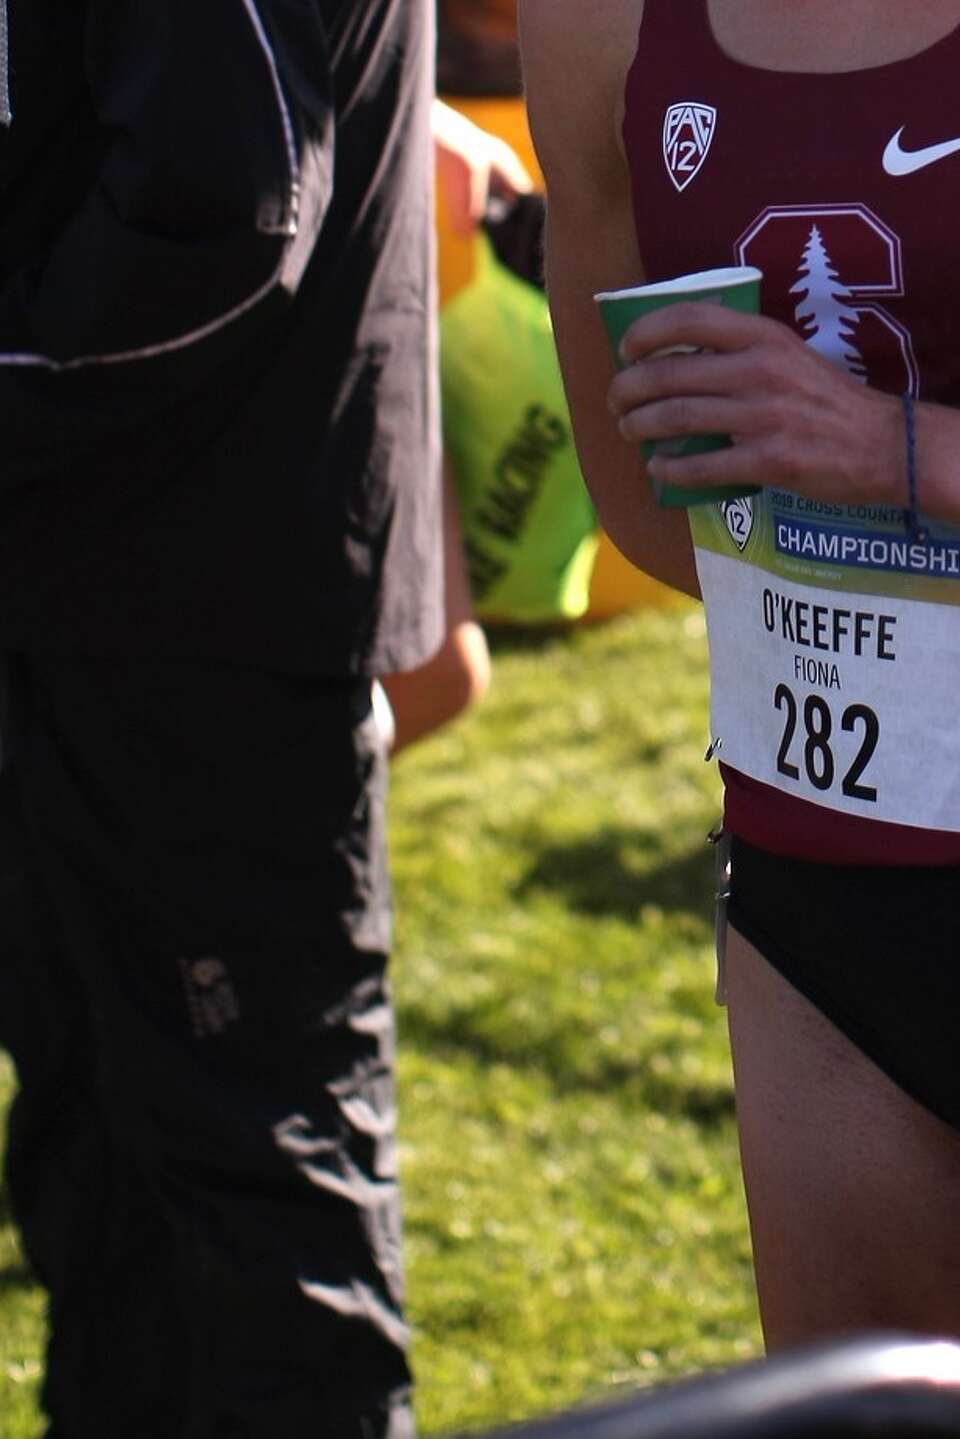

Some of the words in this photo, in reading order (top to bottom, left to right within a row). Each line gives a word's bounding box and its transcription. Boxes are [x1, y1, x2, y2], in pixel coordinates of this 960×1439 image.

[666, 107, 713, 155] PAC
[672, 141, 697, 171] 12
[730, 511, 746, 535] 12
[796, 497, 842, 516] CROSS
[763, 588, 897, 661] O'KEEFFE
[794, 655, 841, 690] FIONA
[774, 683, 880, 803] 282
